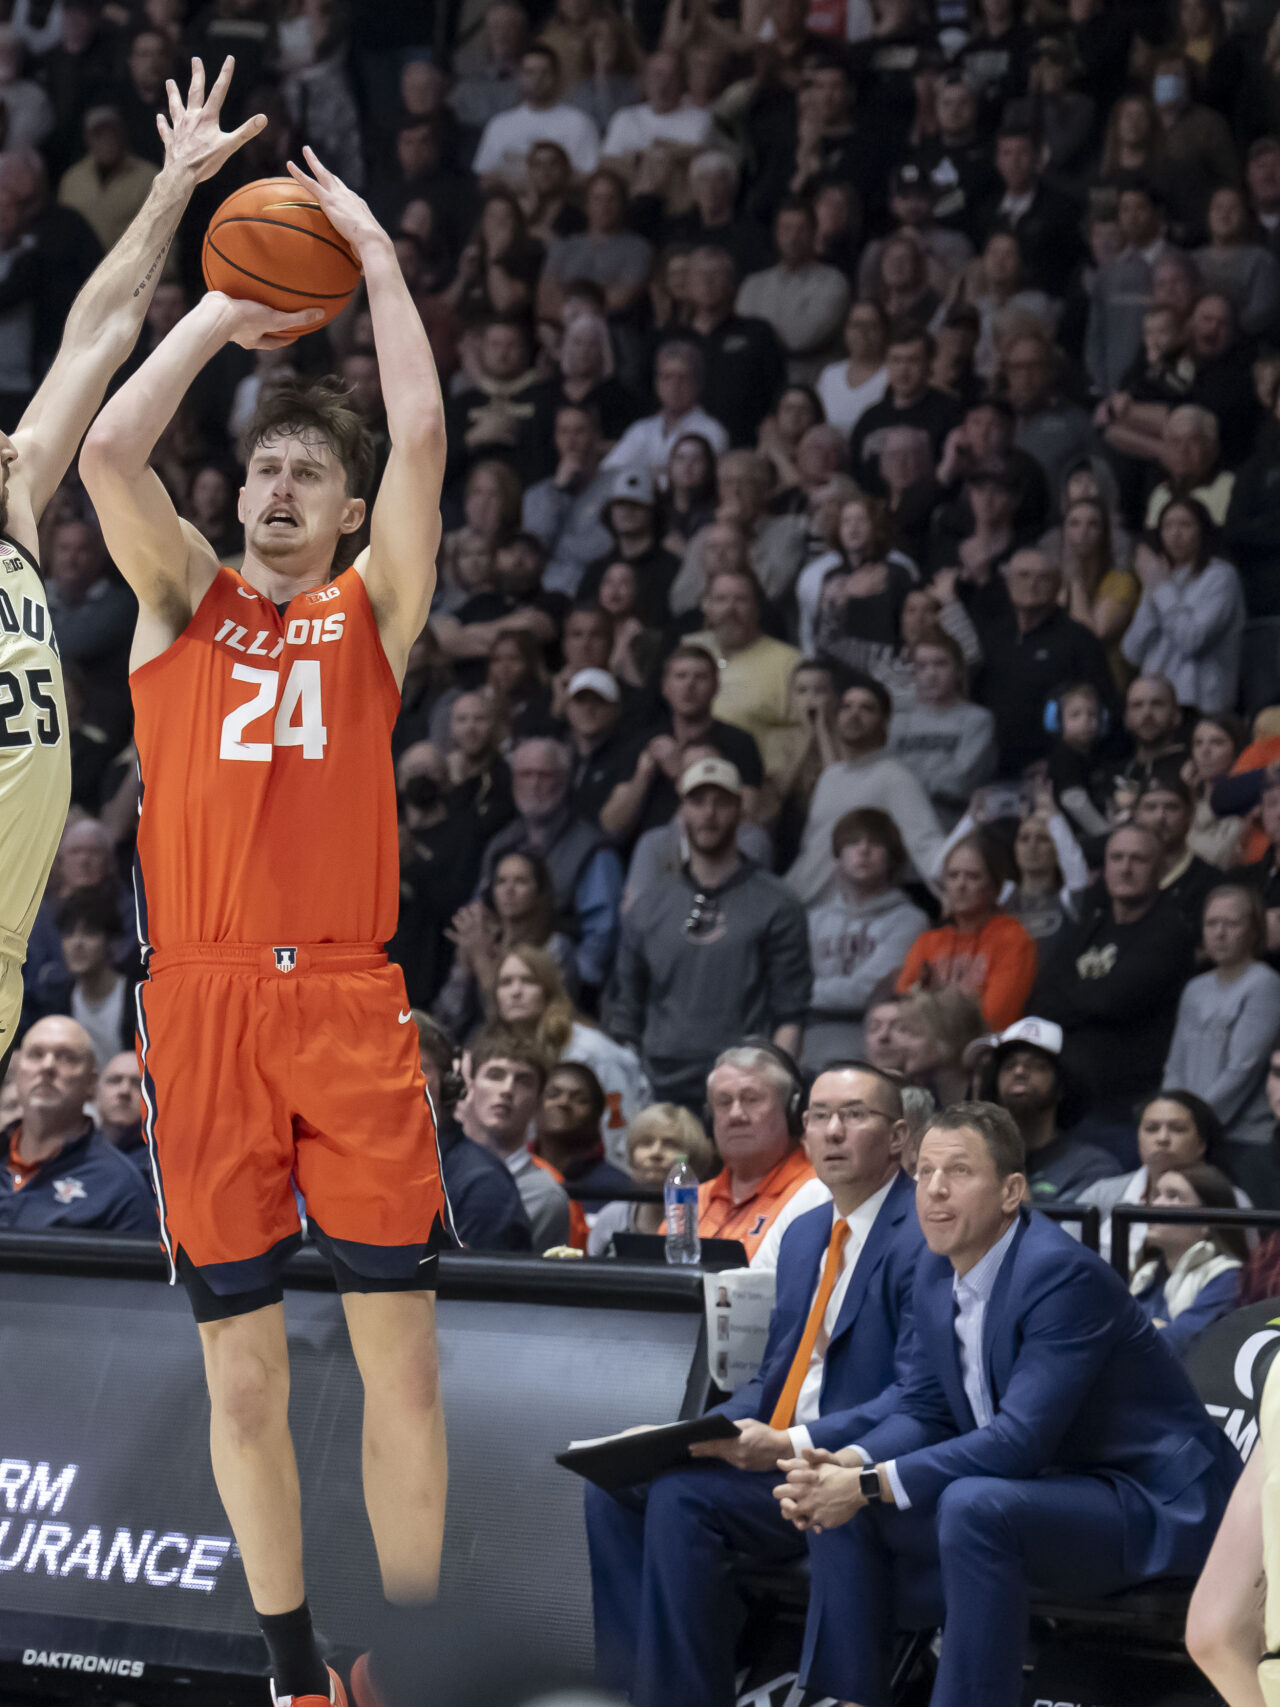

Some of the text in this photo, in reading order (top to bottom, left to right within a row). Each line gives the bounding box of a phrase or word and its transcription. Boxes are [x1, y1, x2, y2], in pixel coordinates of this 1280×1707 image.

[214, 612, 346, 659] ILLIOIS
[219, 660, 328, 762] 24
[22, 1650, 145, 1678] DAKTRONICS
